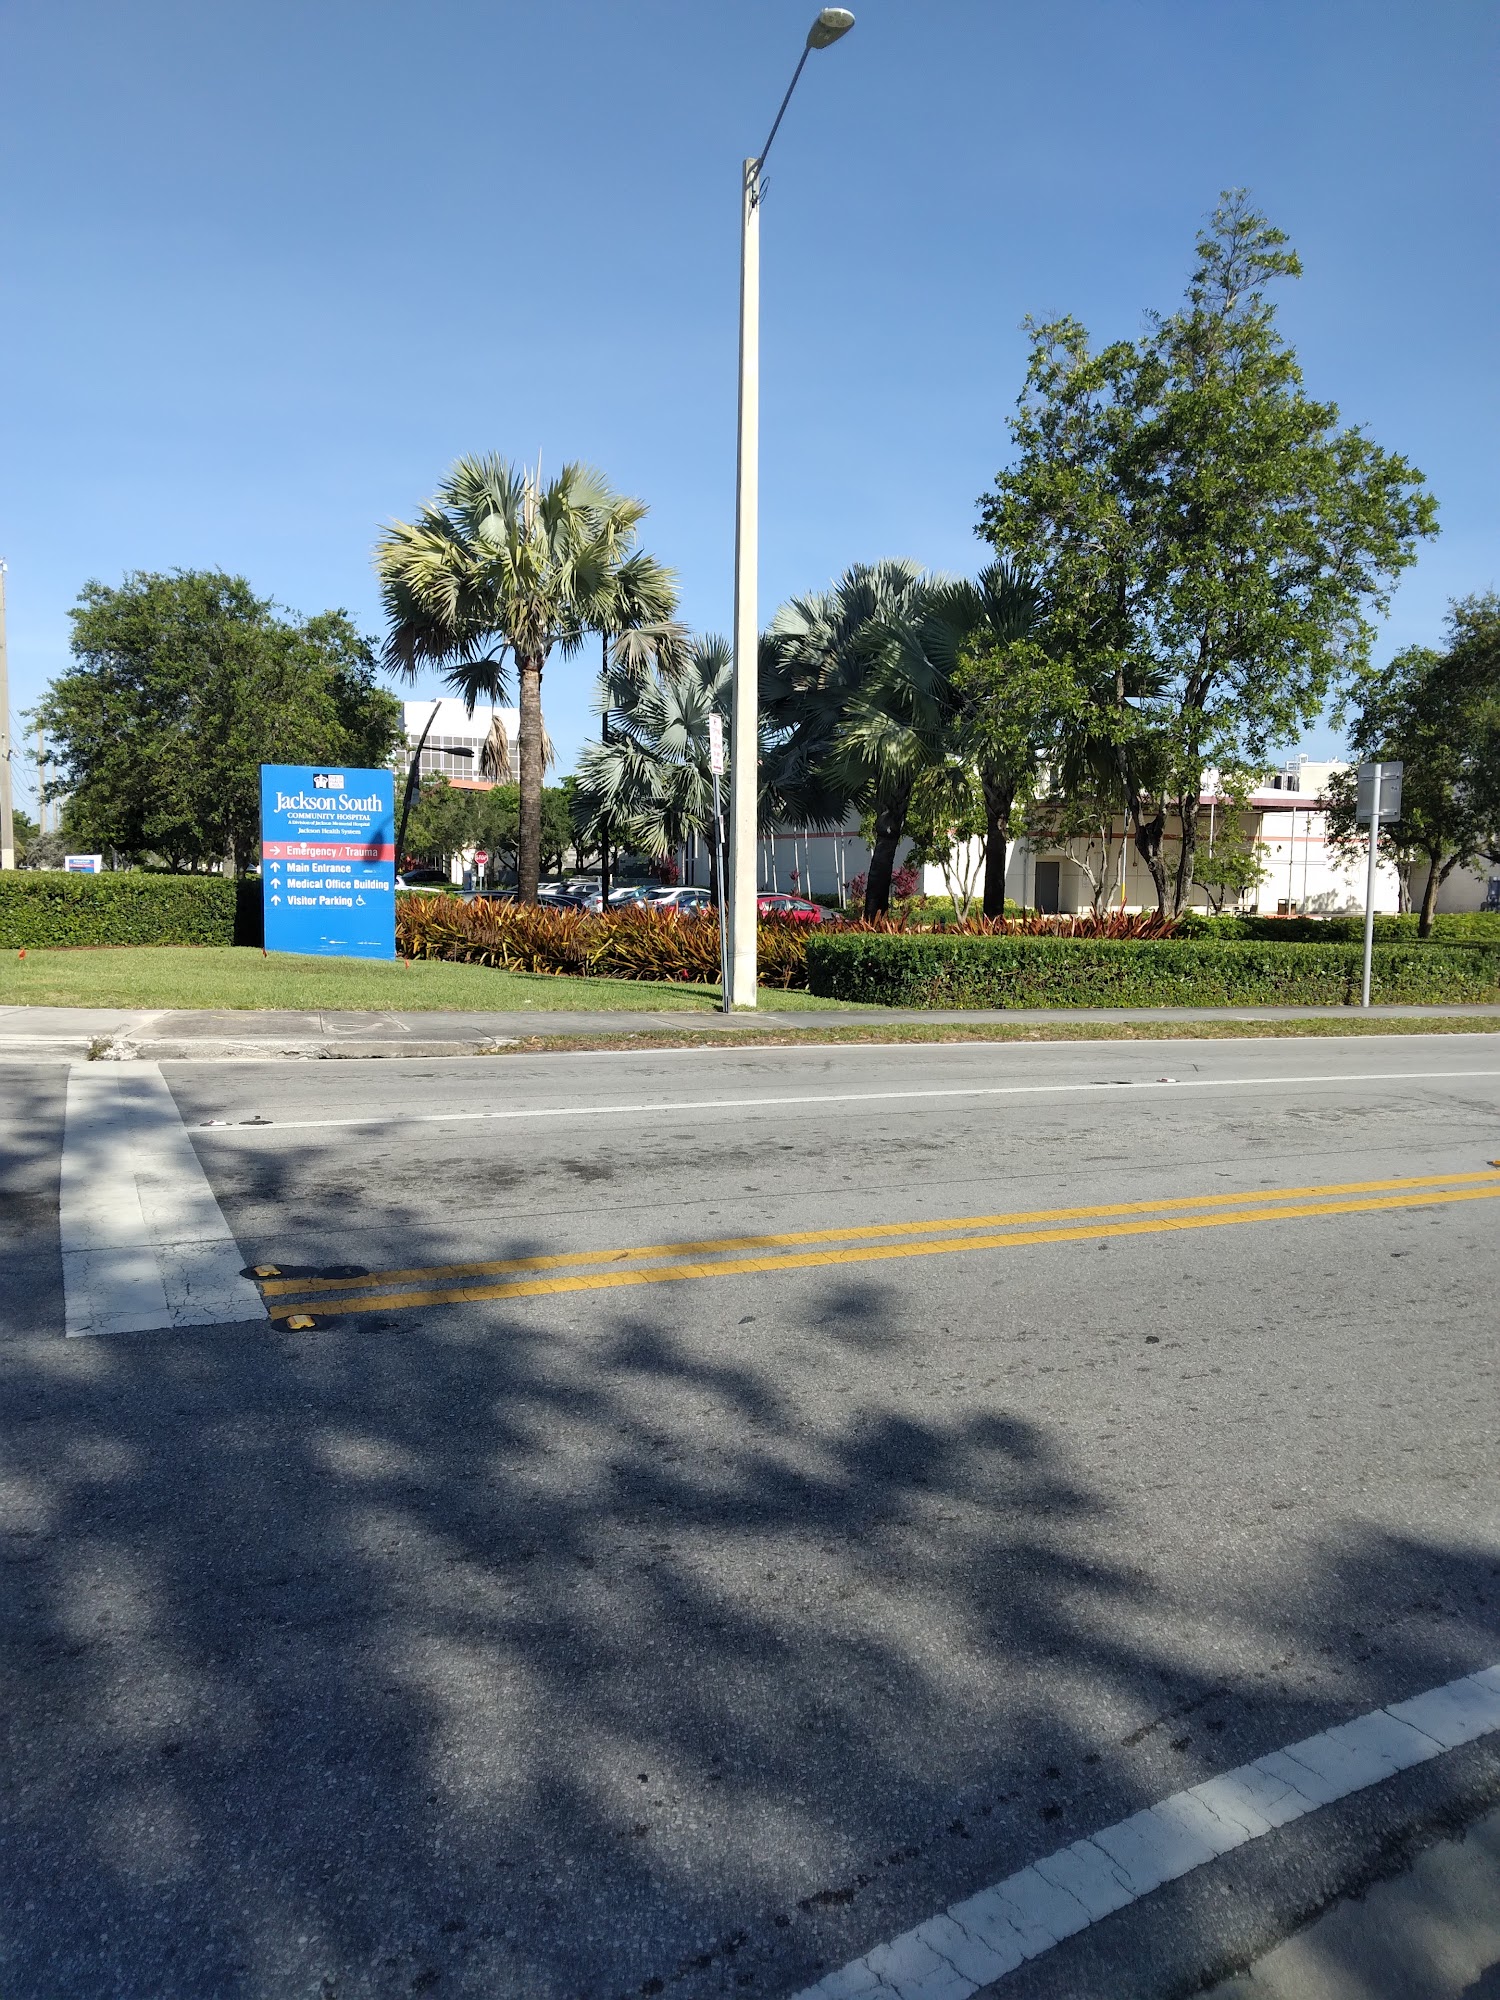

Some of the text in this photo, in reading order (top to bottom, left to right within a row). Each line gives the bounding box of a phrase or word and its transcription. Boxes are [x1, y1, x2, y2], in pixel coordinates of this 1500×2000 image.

[273, 791, 382, 813] Jackson South
[287, 812, 371, 821] COMMUNITY HOSPITAL
[341, 828, 361, 836] System
[287, 846, 336, 857] Emergency
[345, 847, 378, 857] Trauma
[287, 863, 351, 873] Main Entrance
[287, 879, 389, 891] Medical Office Building
[287, 896, 353, 907] Visitor Parking
